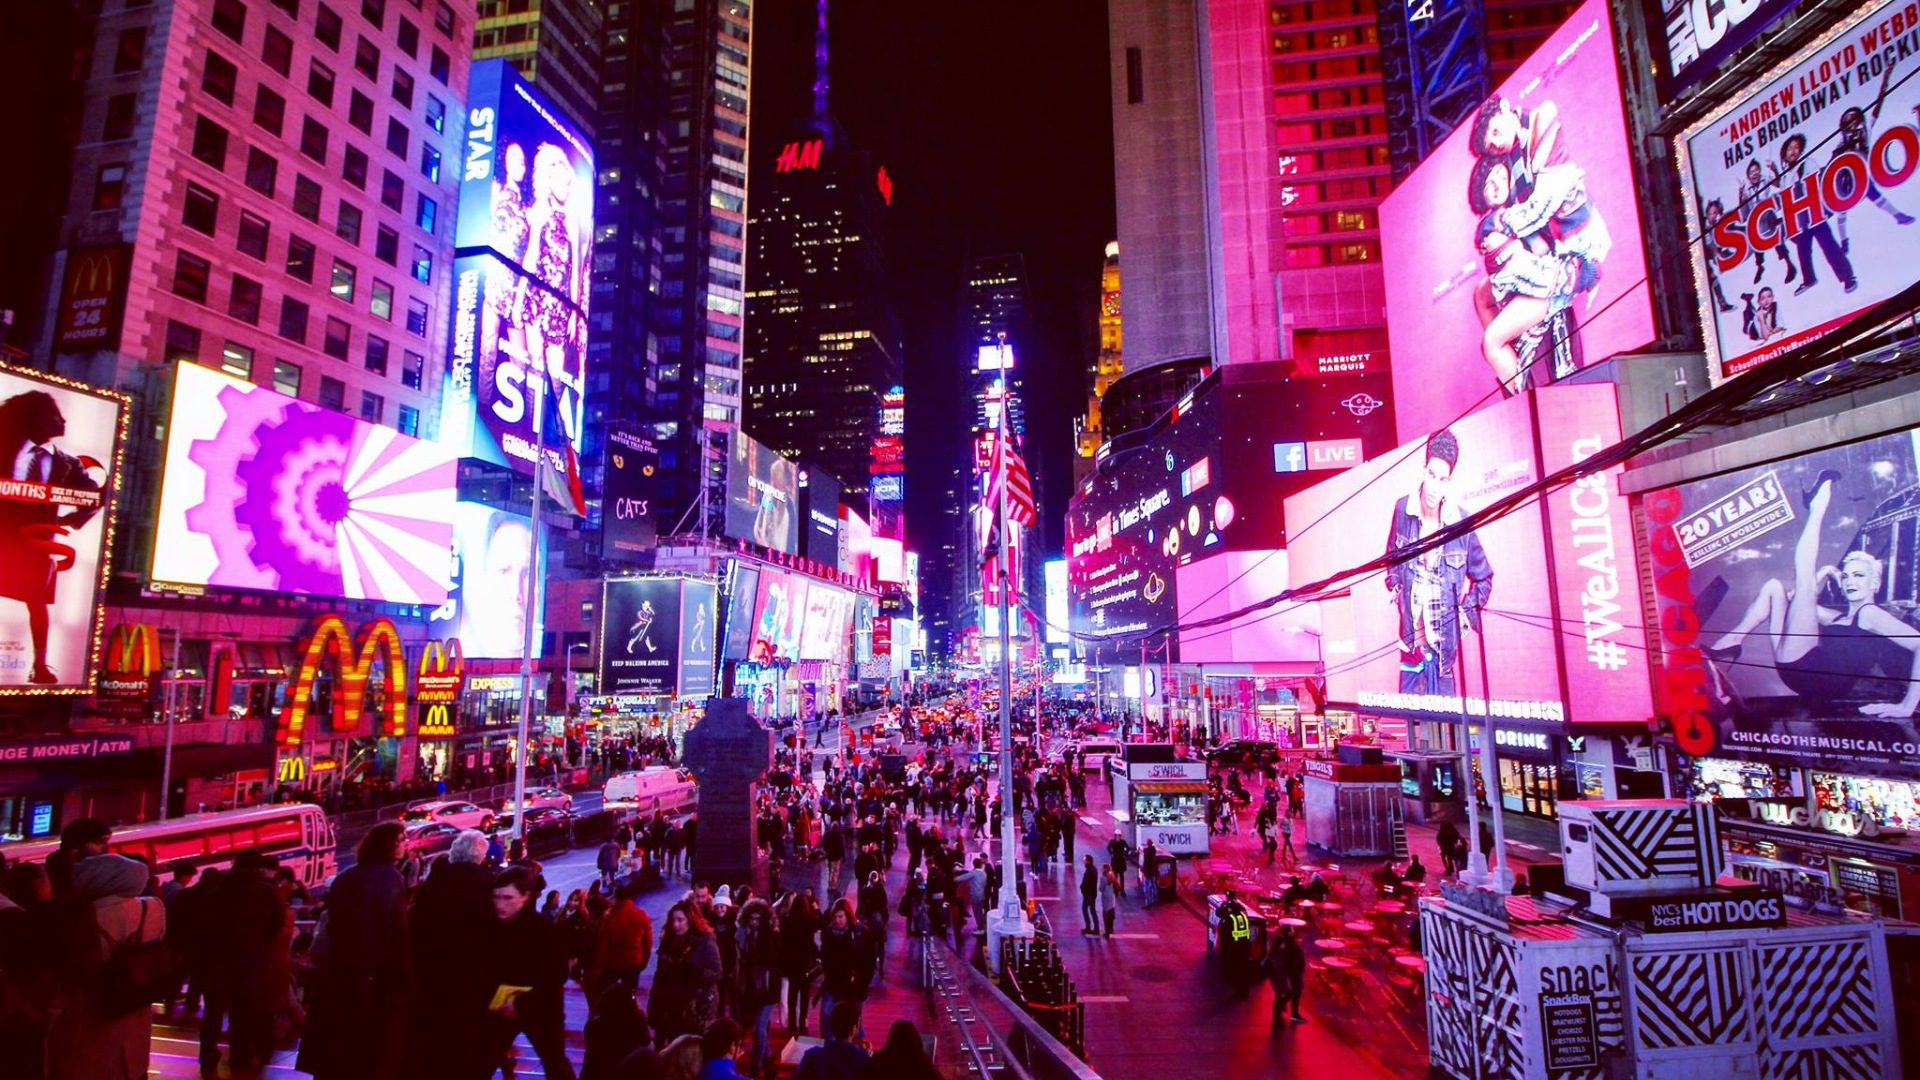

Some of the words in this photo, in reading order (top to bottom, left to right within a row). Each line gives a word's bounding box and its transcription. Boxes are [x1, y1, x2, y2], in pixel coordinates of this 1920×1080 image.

[1800, 44, 1856, 97] LLOYD
[1724, 136, 1755, 169] HAS
[1758, 70, 1852, 149] BROADWAY
[464, 106, 494, 182] STAR
[1713, 103, 1920, 274] SCHOO
[72, 297, 107, 309] OPEN
[73, 309, 101, 327] 24
[63, 327, 107, 339] HOURS
[1318, 353, 1371, 366] MARRIOTT
[1319, 362, 1366, 373] MARQUIS
[1314, 446, 1356, 463] LIVE
[0, 481, 47, 500] ONTHS
[616, 497, 648, 520] CATS
[1679, 516, 1711, 547] 20
[1707, 477, 1780, 530] YEARS
[1119, 507, 1140, 531] Times
[1693, 542, 1723, 559] KILLING
[1730, 512, 1781, 539] WORLDWIDE
[101, 680, 148, 690] McDonald's
[418, 676, 460, 685] McDonald's
[470, 676, 515, 691] EXPRESS
[1495, 729, 1549, 751] DRINK
[32, 743, 91, 758] MONEY
[99, 741, 131, 753] ATM
[1653, 914, 1682, 926] best
[1682, 902, 1722, 925] HOT
[1724, 898, 1780, 923] DOGS
[1540, 954, 1621, 993] snack
[1543, 993, 1592, 1006] SnackBox
[1557, 1027, 1584, 1036] CHORIZO
